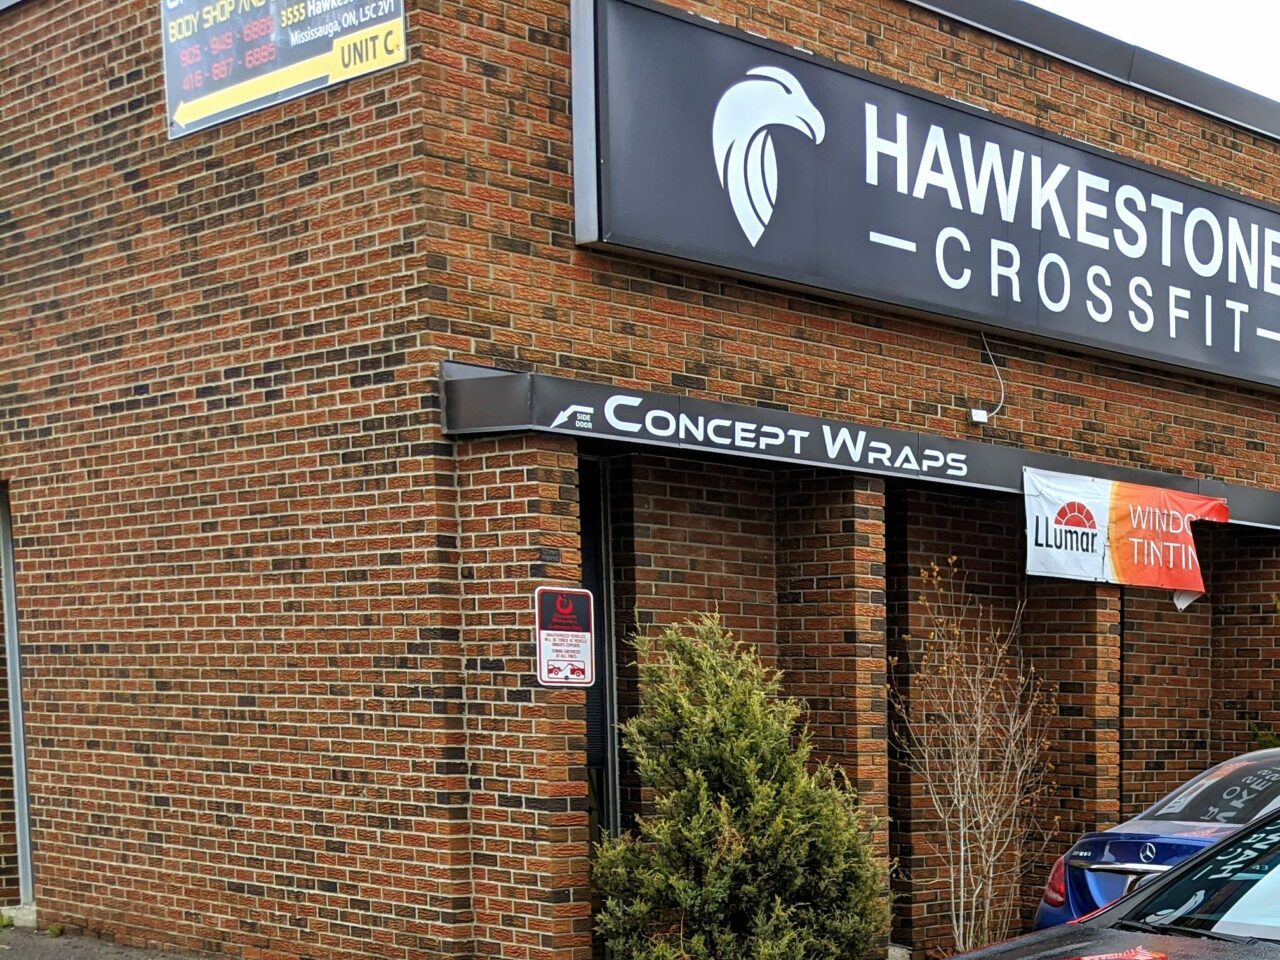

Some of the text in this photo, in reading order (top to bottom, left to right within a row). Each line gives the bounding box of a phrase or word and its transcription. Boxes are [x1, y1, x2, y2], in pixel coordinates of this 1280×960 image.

[168, 11, 200, 43] BODY
[202, 0, 235, 29] SHOP
[280, 3, 306, 27] 3555
[289, 20, 341, 47] Mississauga,
[341, 10, 359, 29] ON,
[360, 3, 377, 23] L5C
[341, 29, 395, 69] UNIT C
[934, 226, 1250, 353] CROSSFIT
[575, 421, 593, 429] DOOR
[576, 413, 591, 421] SIDE
[603, 395, 968, 477] CONCEPT WRAPS
[1034, 514, 1098, 554] LLumar
